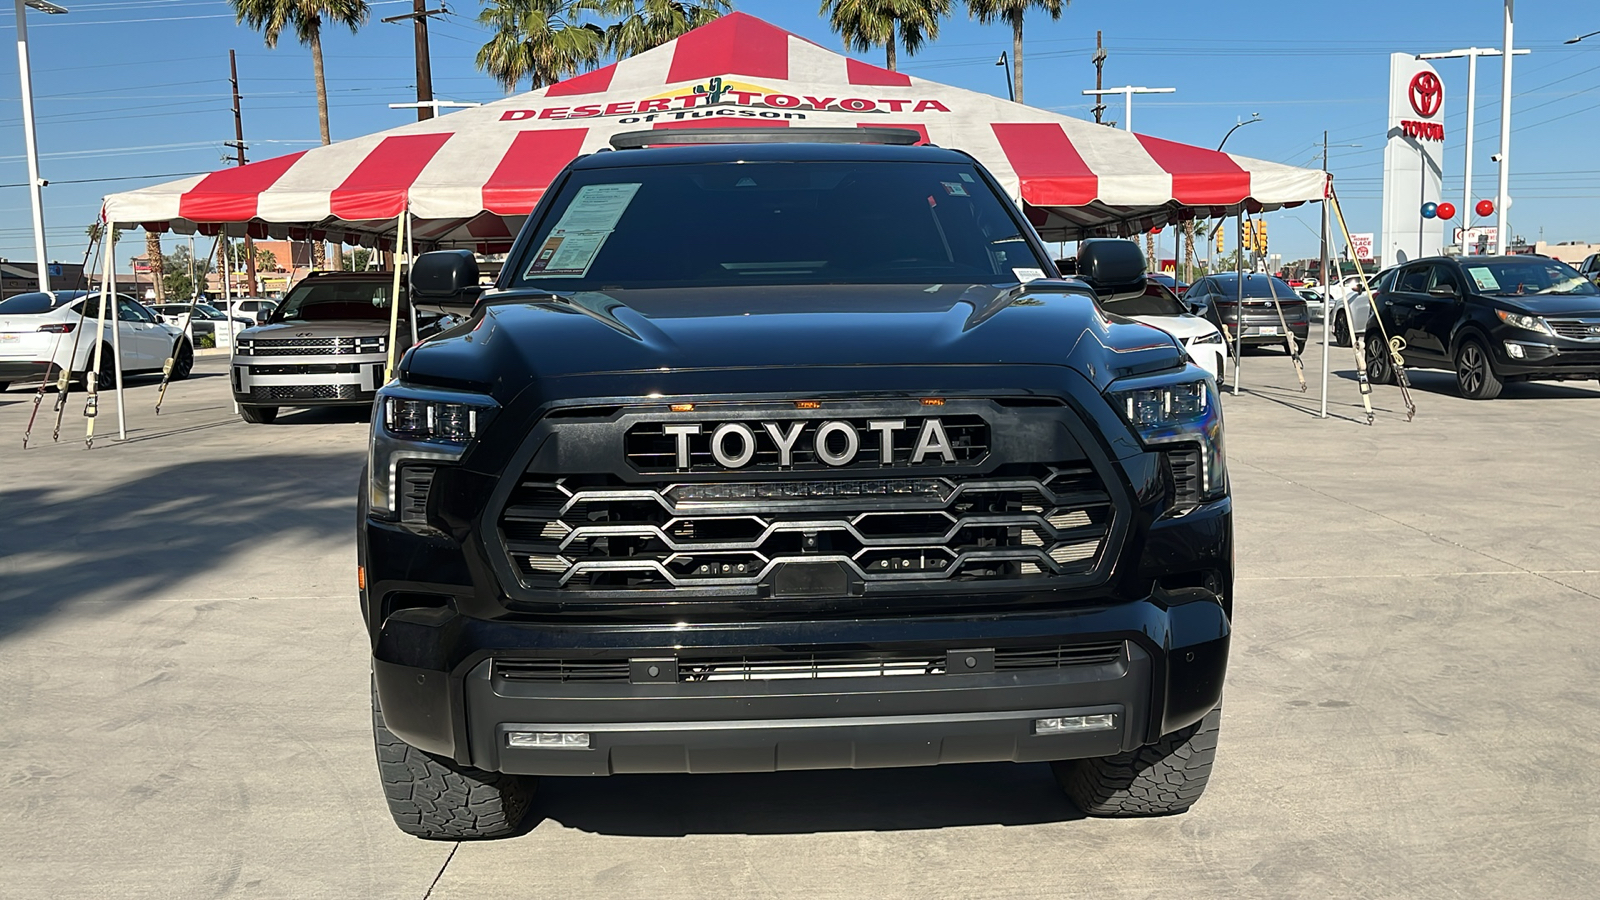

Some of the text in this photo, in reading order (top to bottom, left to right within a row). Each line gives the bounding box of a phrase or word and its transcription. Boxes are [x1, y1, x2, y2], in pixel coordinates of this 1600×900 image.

[498, 90, 952, 122] DESERT TOYOTA
[618, 109, 806, 124] of Tucson
[1401, 120, 1445, 142] TOYOTA
[662, 418, 958, 471] TOYOTA
